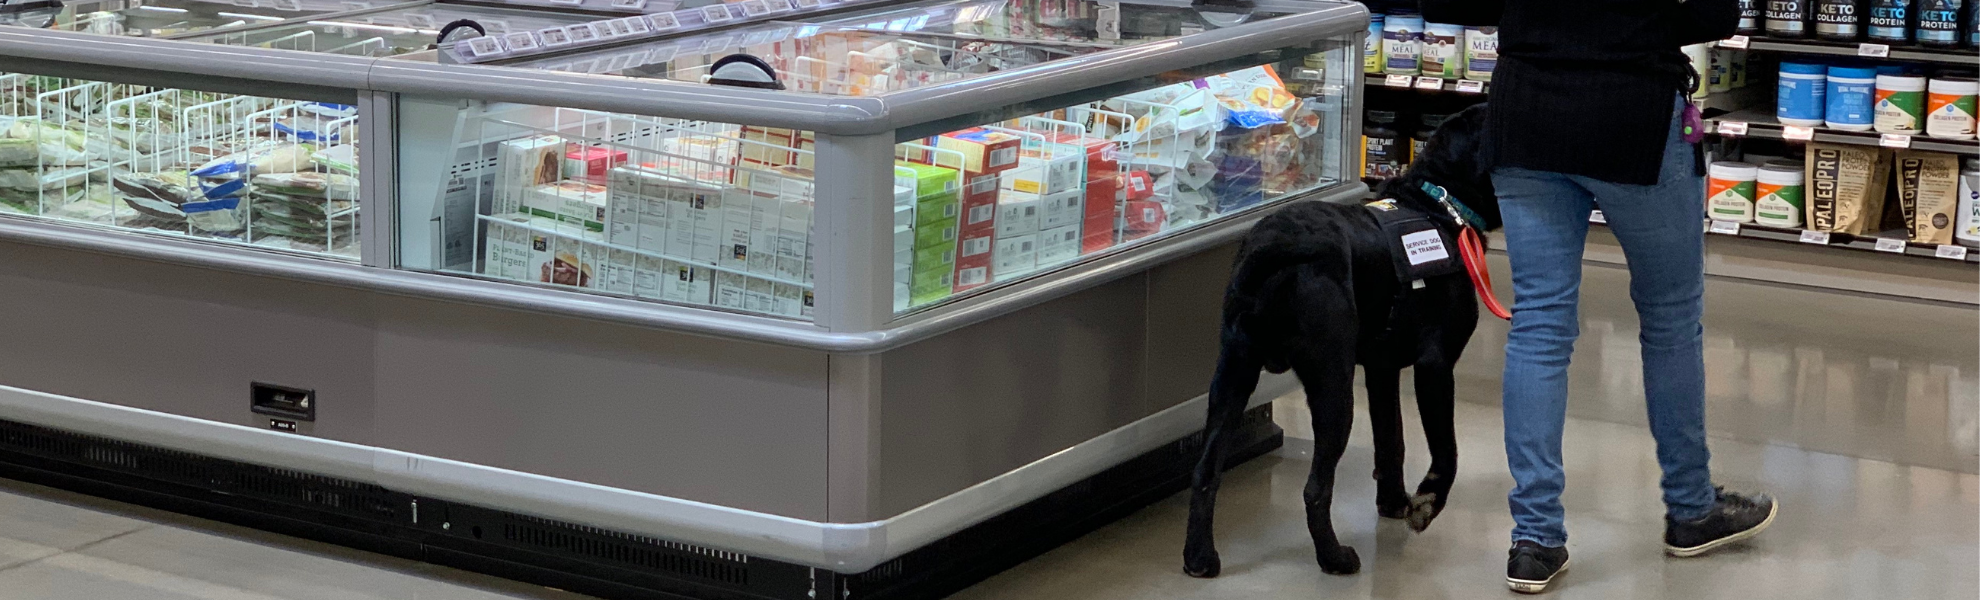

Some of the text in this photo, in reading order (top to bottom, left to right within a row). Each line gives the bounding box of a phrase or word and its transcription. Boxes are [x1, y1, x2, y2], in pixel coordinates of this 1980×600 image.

[1820, 4, 1854, 15] KETO
[1870, 7, 1905, 19] KETO
[1817, 13, 1858, 23] COLLAGEN
[1921, 10, 1957, 22] KETO
[1870, 17, 1905, 26] PROTEIN
[1920, 20, 1957, 29] PROTEIN
[1392, 46, 1414, 54] MEAL
[1472, 40, 1498, 51] MEA
[1405, 240, 1429, 249] SERVICE
[1418, 245, 1442, 253] TRAINING
